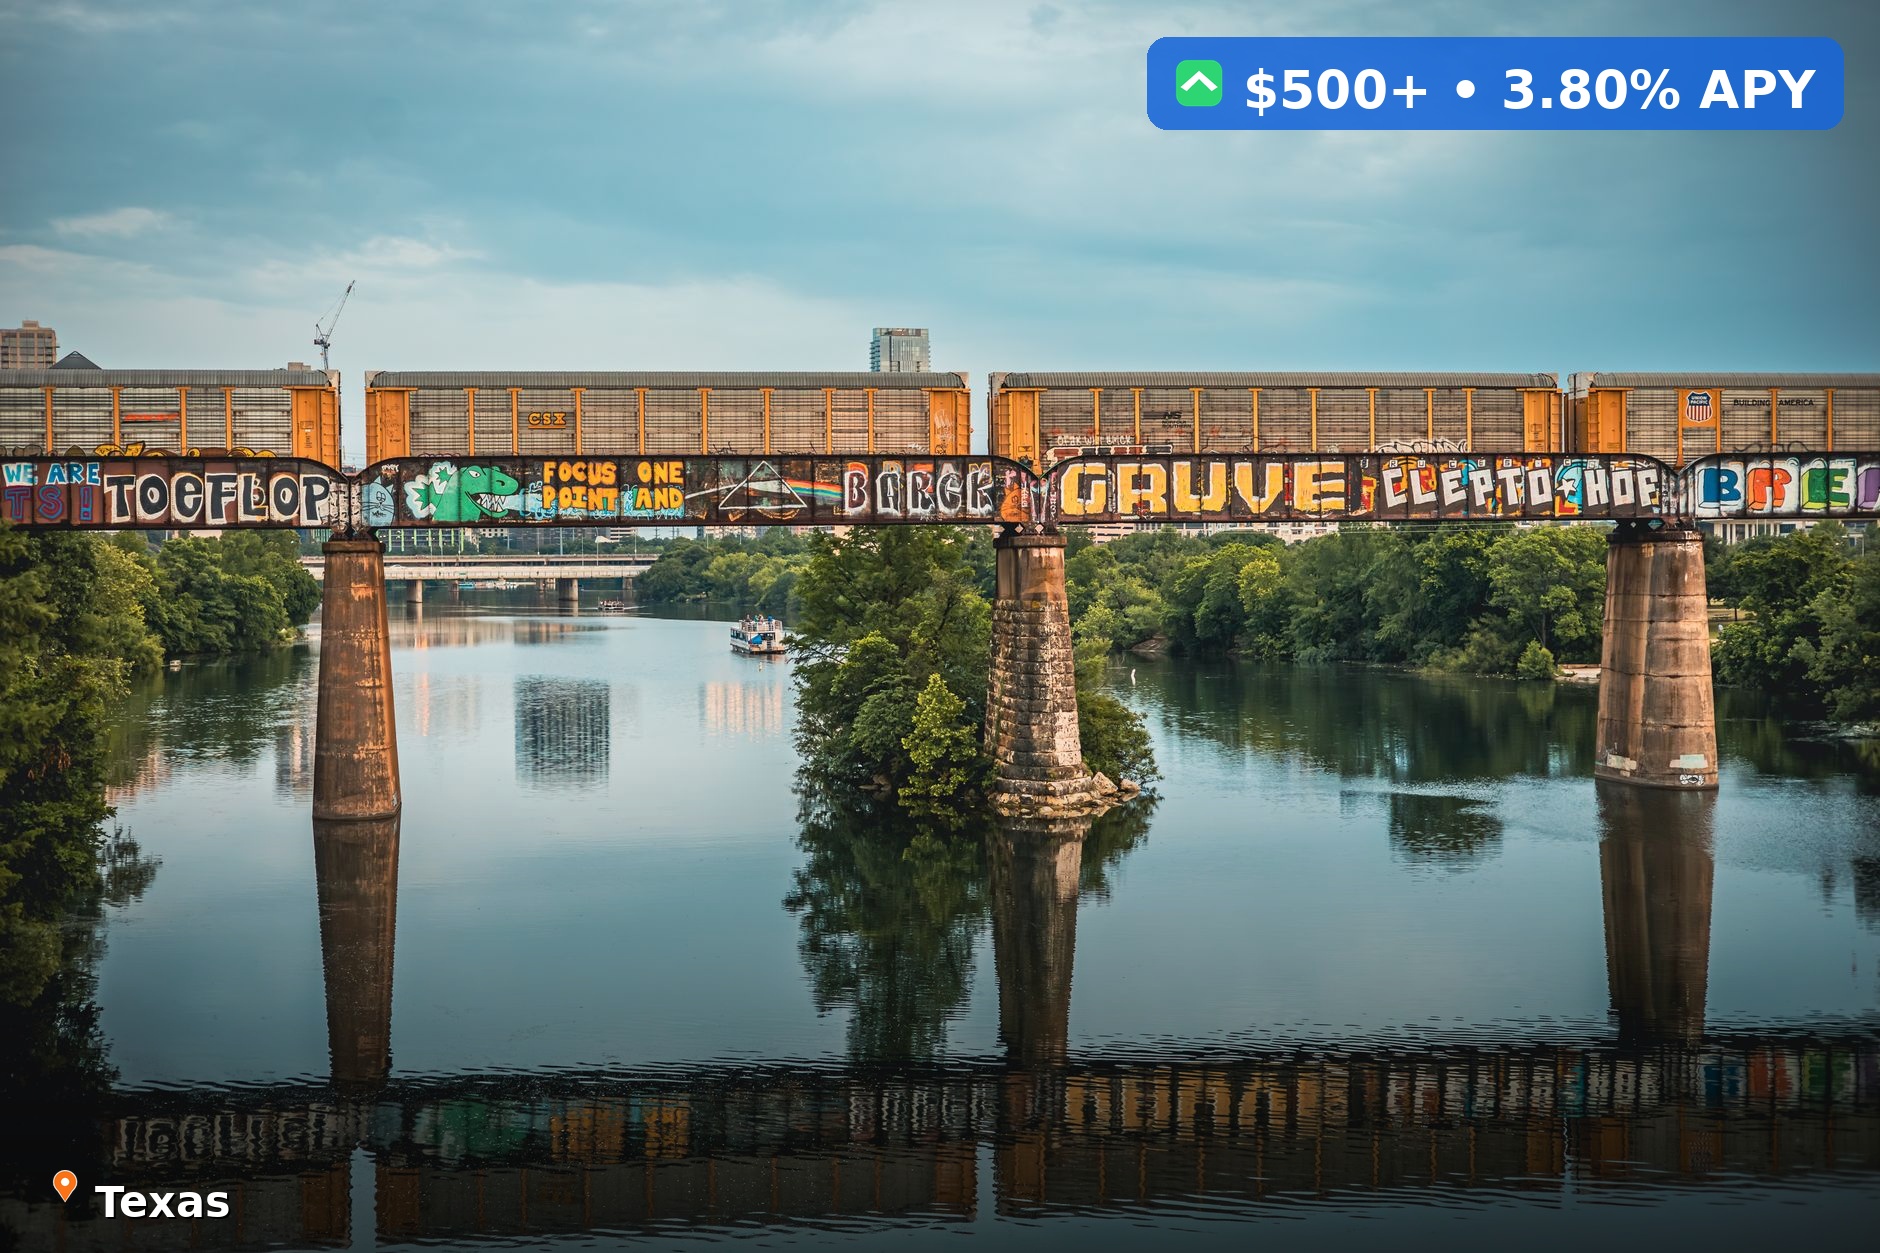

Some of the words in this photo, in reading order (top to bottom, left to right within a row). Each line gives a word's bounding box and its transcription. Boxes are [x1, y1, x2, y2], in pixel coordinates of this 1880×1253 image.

[1733, 399, 1770, 407] BUILDING
[1778, 399, 1815, 407] AMERICA
[528, 411, 567, 426] CSX
[2, 463, 37, 487] WE
[46, 462, 100, 486] ARE
[543, 461, 617, 486] FOCUS
[637, 461, 684, 485] ONE
[542, 484, 619, 511] POINT
[635, 485, 684, 511] AND
[1382, 466, 1553, 509] CLEPTO
